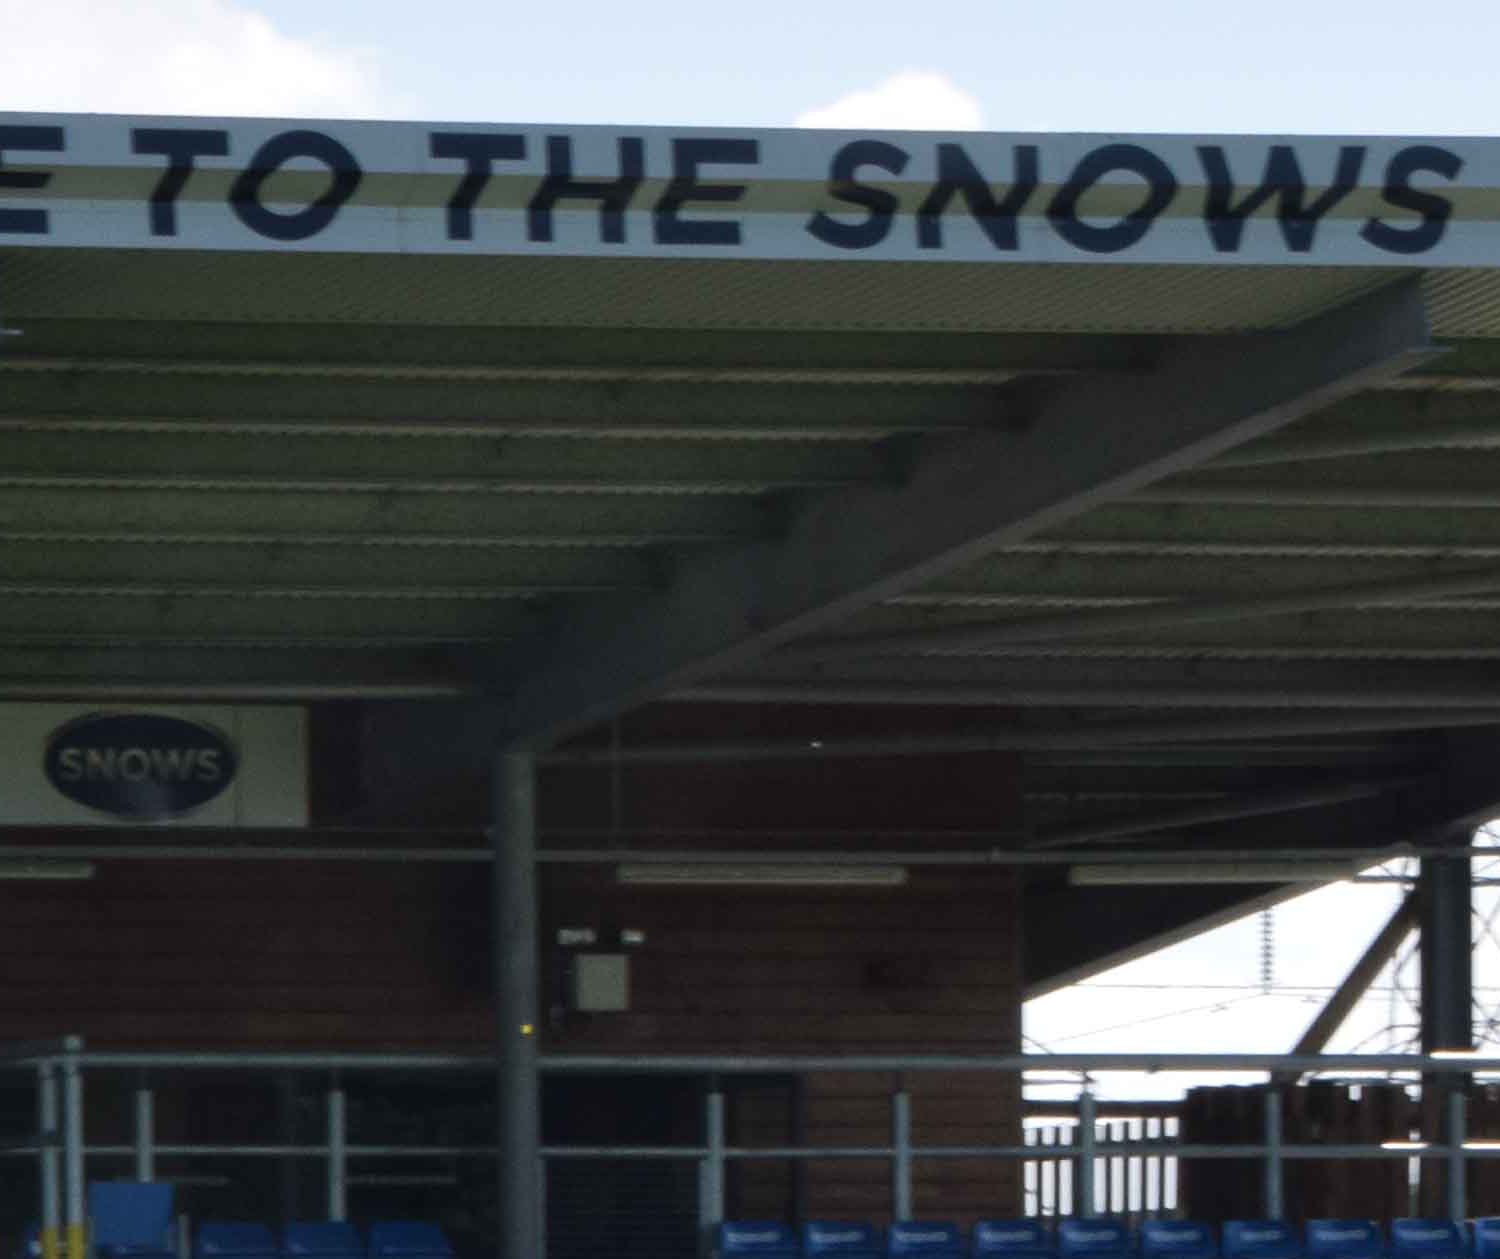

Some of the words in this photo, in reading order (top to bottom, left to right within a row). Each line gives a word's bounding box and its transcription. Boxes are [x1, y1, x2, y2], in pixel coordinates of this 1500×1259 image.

[130, 128, 364, 241] TO
[429, 131, 759, 246] THE
[804, 139, 1464, 255] SNOWS
[58, 747, 221, 782] SNOWS
